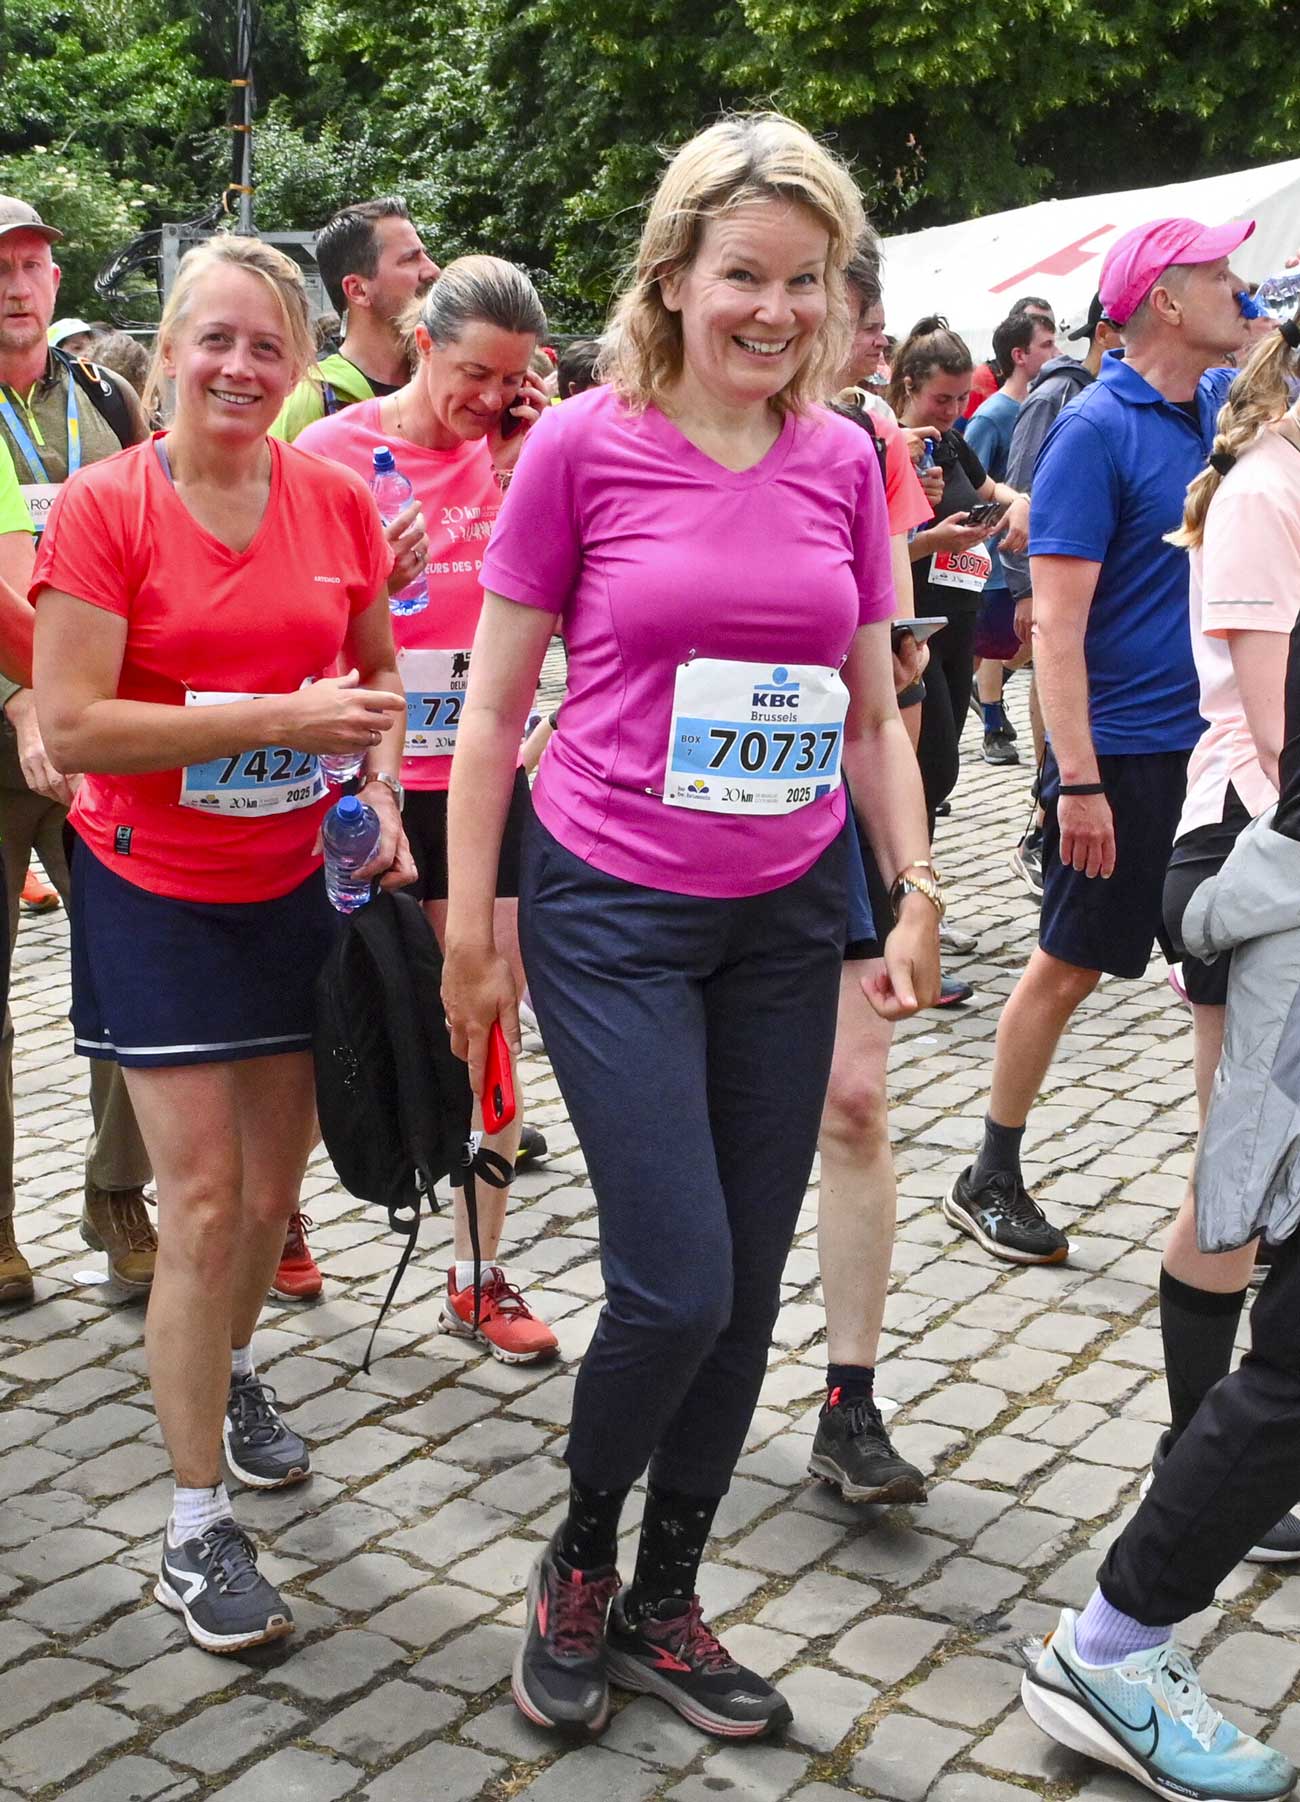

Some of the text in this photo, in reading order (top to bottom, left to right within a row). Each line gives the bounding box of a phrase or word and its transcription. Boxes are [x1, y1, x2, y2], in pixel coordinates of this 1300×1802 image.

[452, 561, 472, 573] DES
[752, 693, 799, 708] KBC
[750, 711, 798, 722] Brussels
[681, 735, 701, 743] BOX
[708, 728, 838, 772] 70737
[286, 786, 310, 803] 2025
[722, 788, 740, 802] 20
[741, 789, 753, 803] km
[786, 787, 811, 803] 2025
